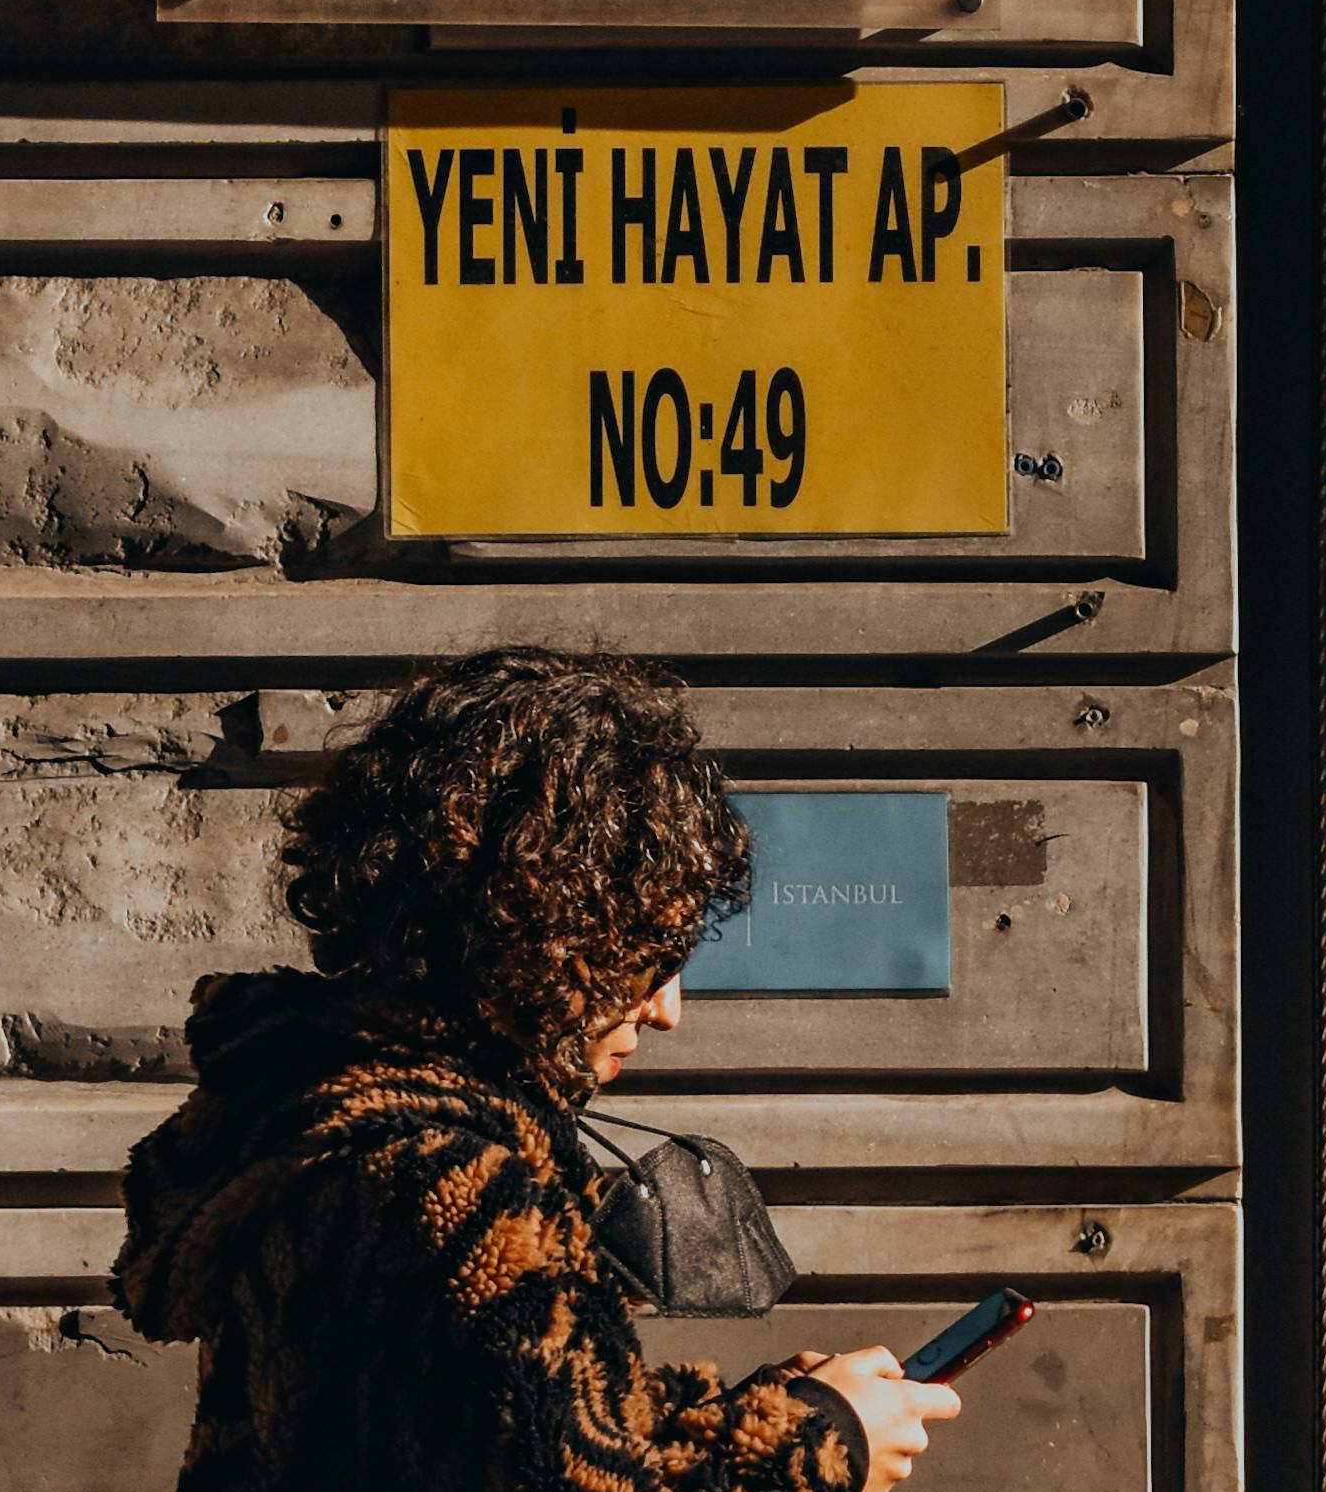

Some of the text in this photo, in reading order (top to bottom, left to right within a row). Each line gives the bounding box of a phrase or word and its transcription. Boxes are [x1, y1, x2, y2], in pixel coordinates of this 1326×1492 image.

[407, 107, 982, 286] YENİ HAYAT AP.
[589, 366, 807, 509] NO:49
